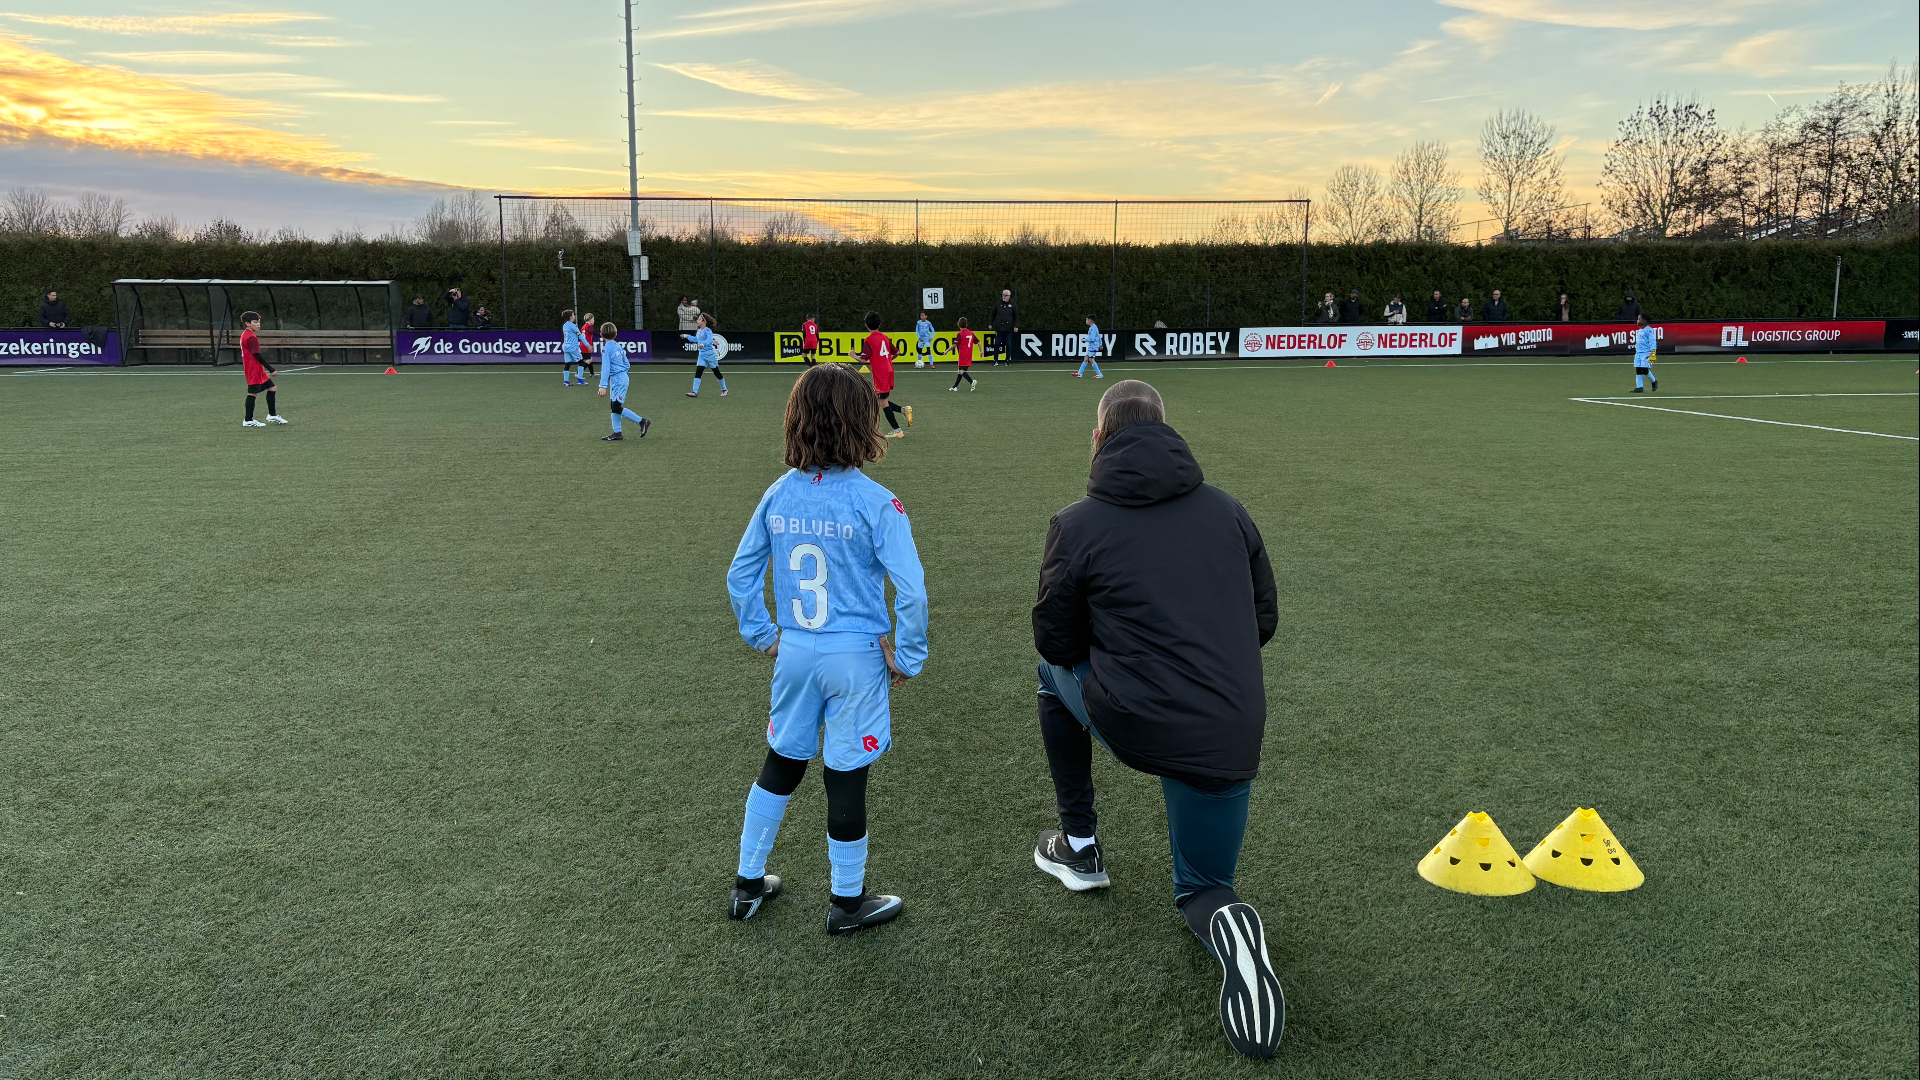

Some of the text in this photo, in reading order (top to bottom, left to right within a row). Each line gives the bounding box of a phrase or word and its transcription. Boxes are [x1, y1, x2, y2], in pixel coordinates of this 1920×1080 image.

[809, 325, 816, 335] 9
[1500, 327, 1553, 346] VIA SPARTA
[1611, 331, 1627, 345] VIA
[1720, 326, 1841, 347] DL LOGISTICS GROUP
[434, 339, 453, 353] de
[459, 339, 521, 354] Goudse
[880, 340, 890, 359] 4
[966, 336, 973, 348] 7
[1165, 331, 1230, 356] ROBEY
[1265, 333, 1348, 350] NEDERLOF
[1377, 332, 1458, 349] NEDERLOF
[789, 517, 853, 540] BLUE10
[789, 543, 829, 630] 3
